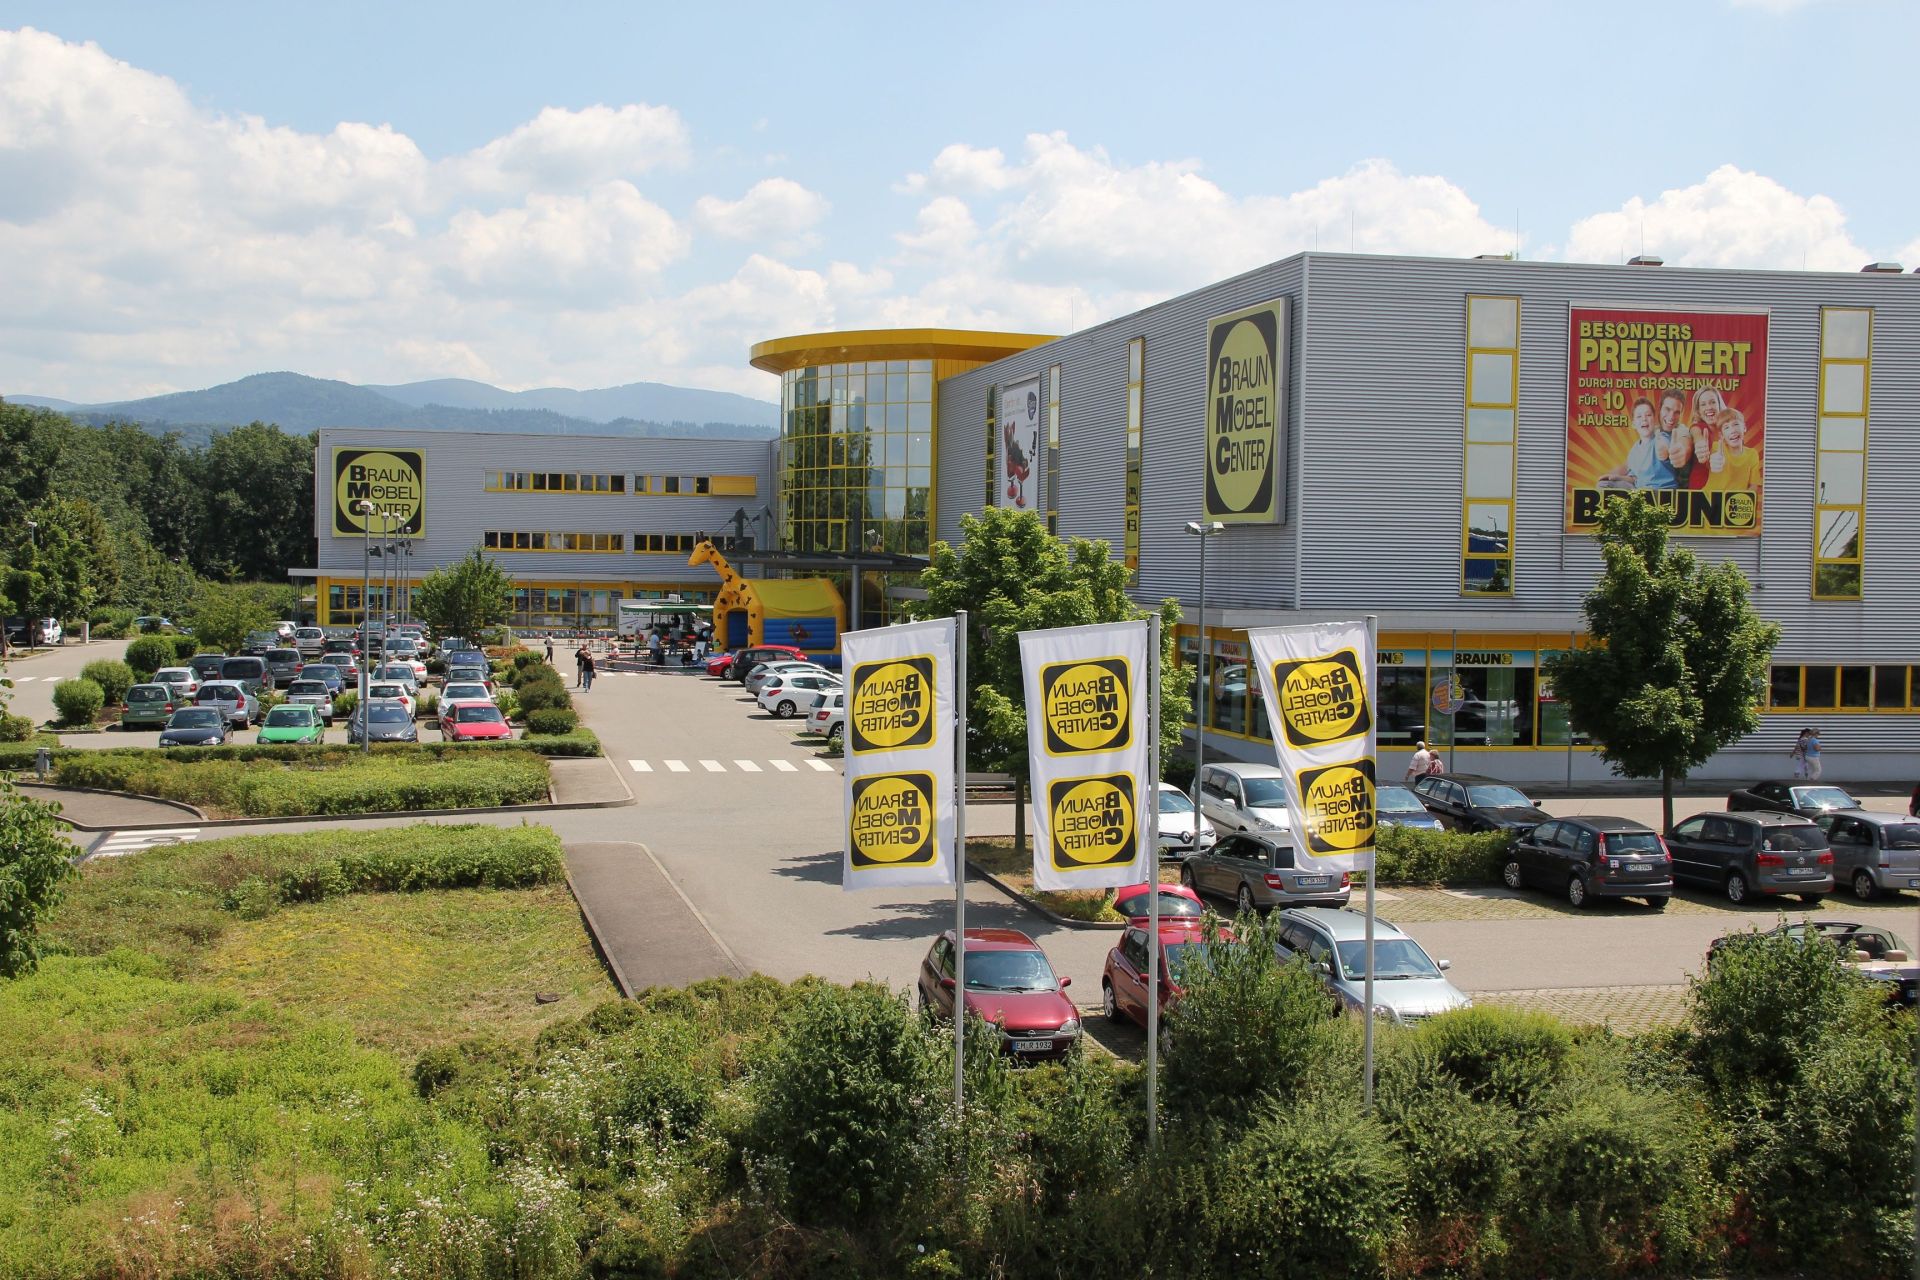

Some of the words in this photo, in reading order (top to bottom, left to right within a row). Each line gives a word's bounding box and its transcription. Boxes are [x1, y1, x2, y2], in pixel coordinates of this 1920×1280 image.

[1580, 321, 1692, 339] BESONDERS
[1579, 338, 1751, 375] PREISWERT
[1219, 354, 1268, 394] BRAUN
[1578, 377, 1613, 389] DURCH
[1616, 378, 1637, 389] DEN
[1578, 393, 1598, 406] FÜR
[1603, 391, 1625, 410] 10
[1216, 394, 1272, 434] MÖBEL
[1577, 412, 1629, 427] HÄUSER
[1215, 436, 1266, 475] CENTER
[350, 465, 412, 482] BRAUN
[347, 482, 418, 500] MÖBEL
[1455, 653, 1502, 664] BRAUN
[1036, 1041, 1052, 1049] 1932
